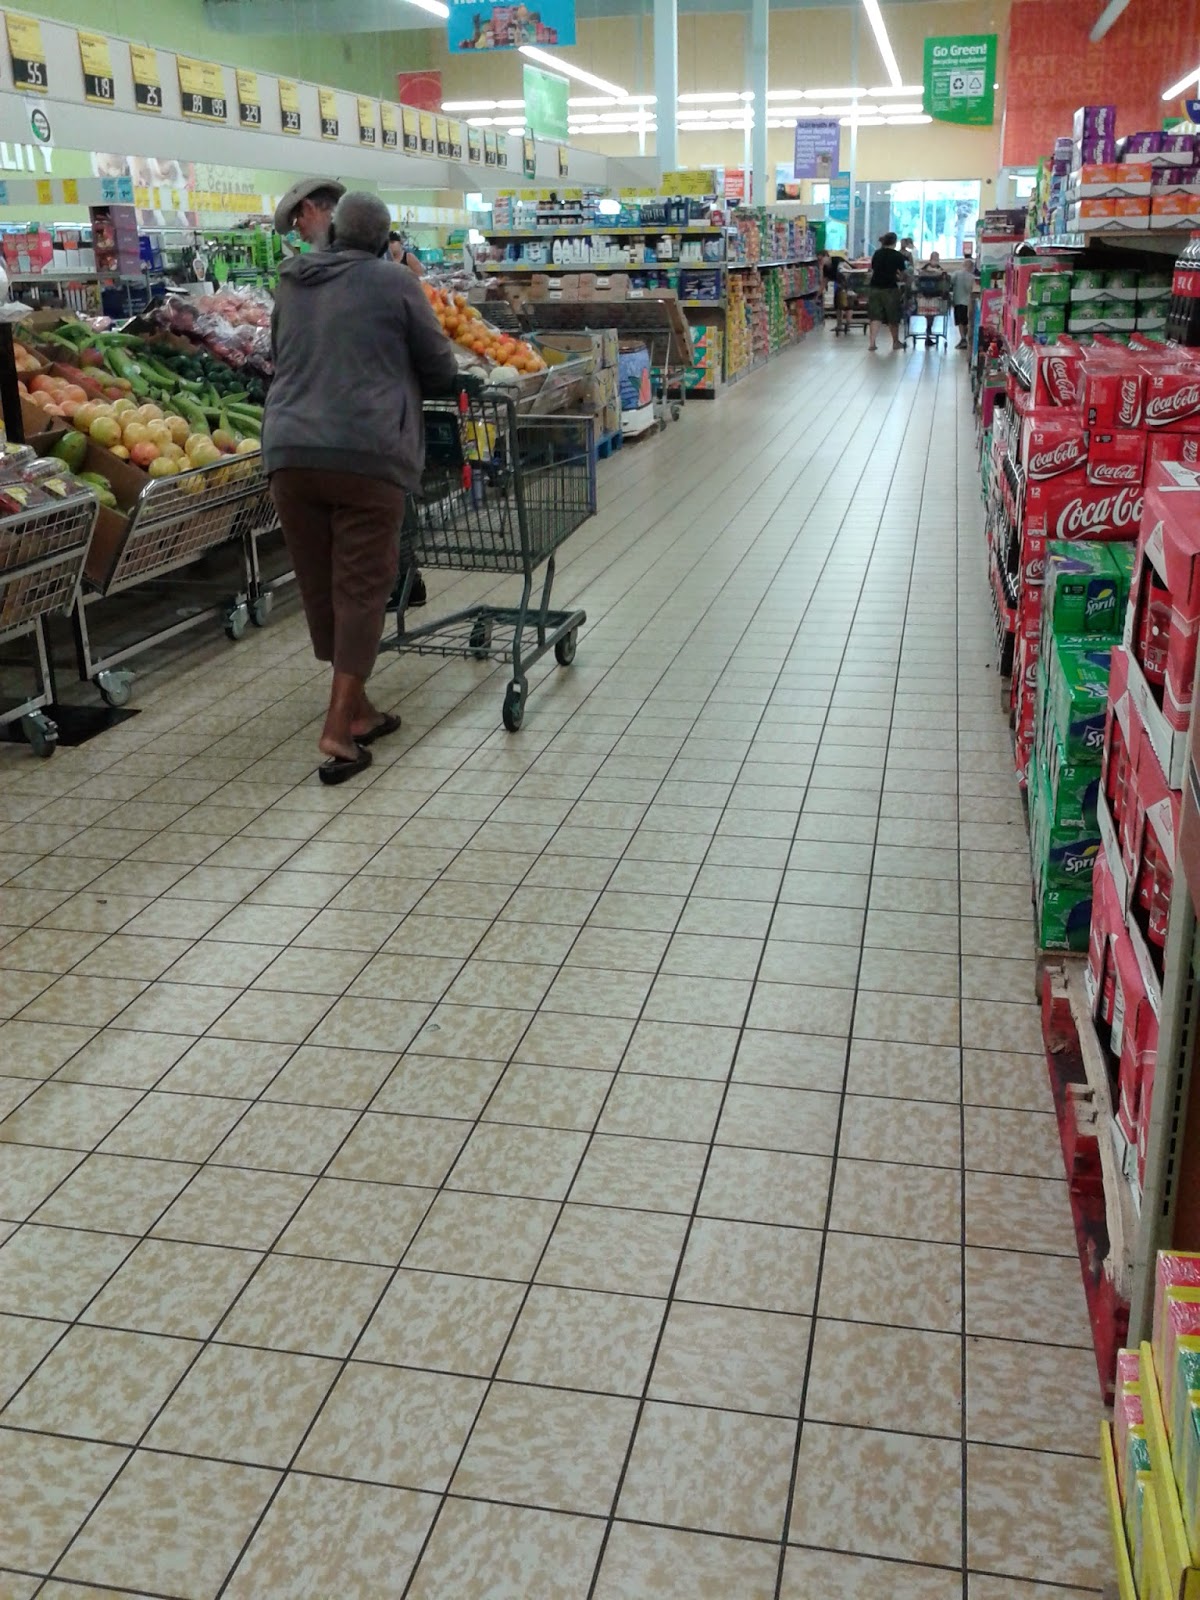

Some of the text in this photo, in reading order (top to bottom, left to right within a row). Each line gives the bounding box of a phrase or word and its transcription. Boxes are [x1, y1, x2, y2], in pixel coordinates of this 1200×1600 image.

[933, 43, 987, 57] Go Green!
[1153, 377, 1164, 386] 12
[1033, 433, 1044, 442] 12
[1031, 487, 1041, 495] 12
[1030, 541, 1040, 549] 12
[1028, 591, 1039, 599] 12
[1029, 644, 1039, 652] 12
[1063, 768, 1075, 777] 12
[1048, 892, 1059, 900] 12
